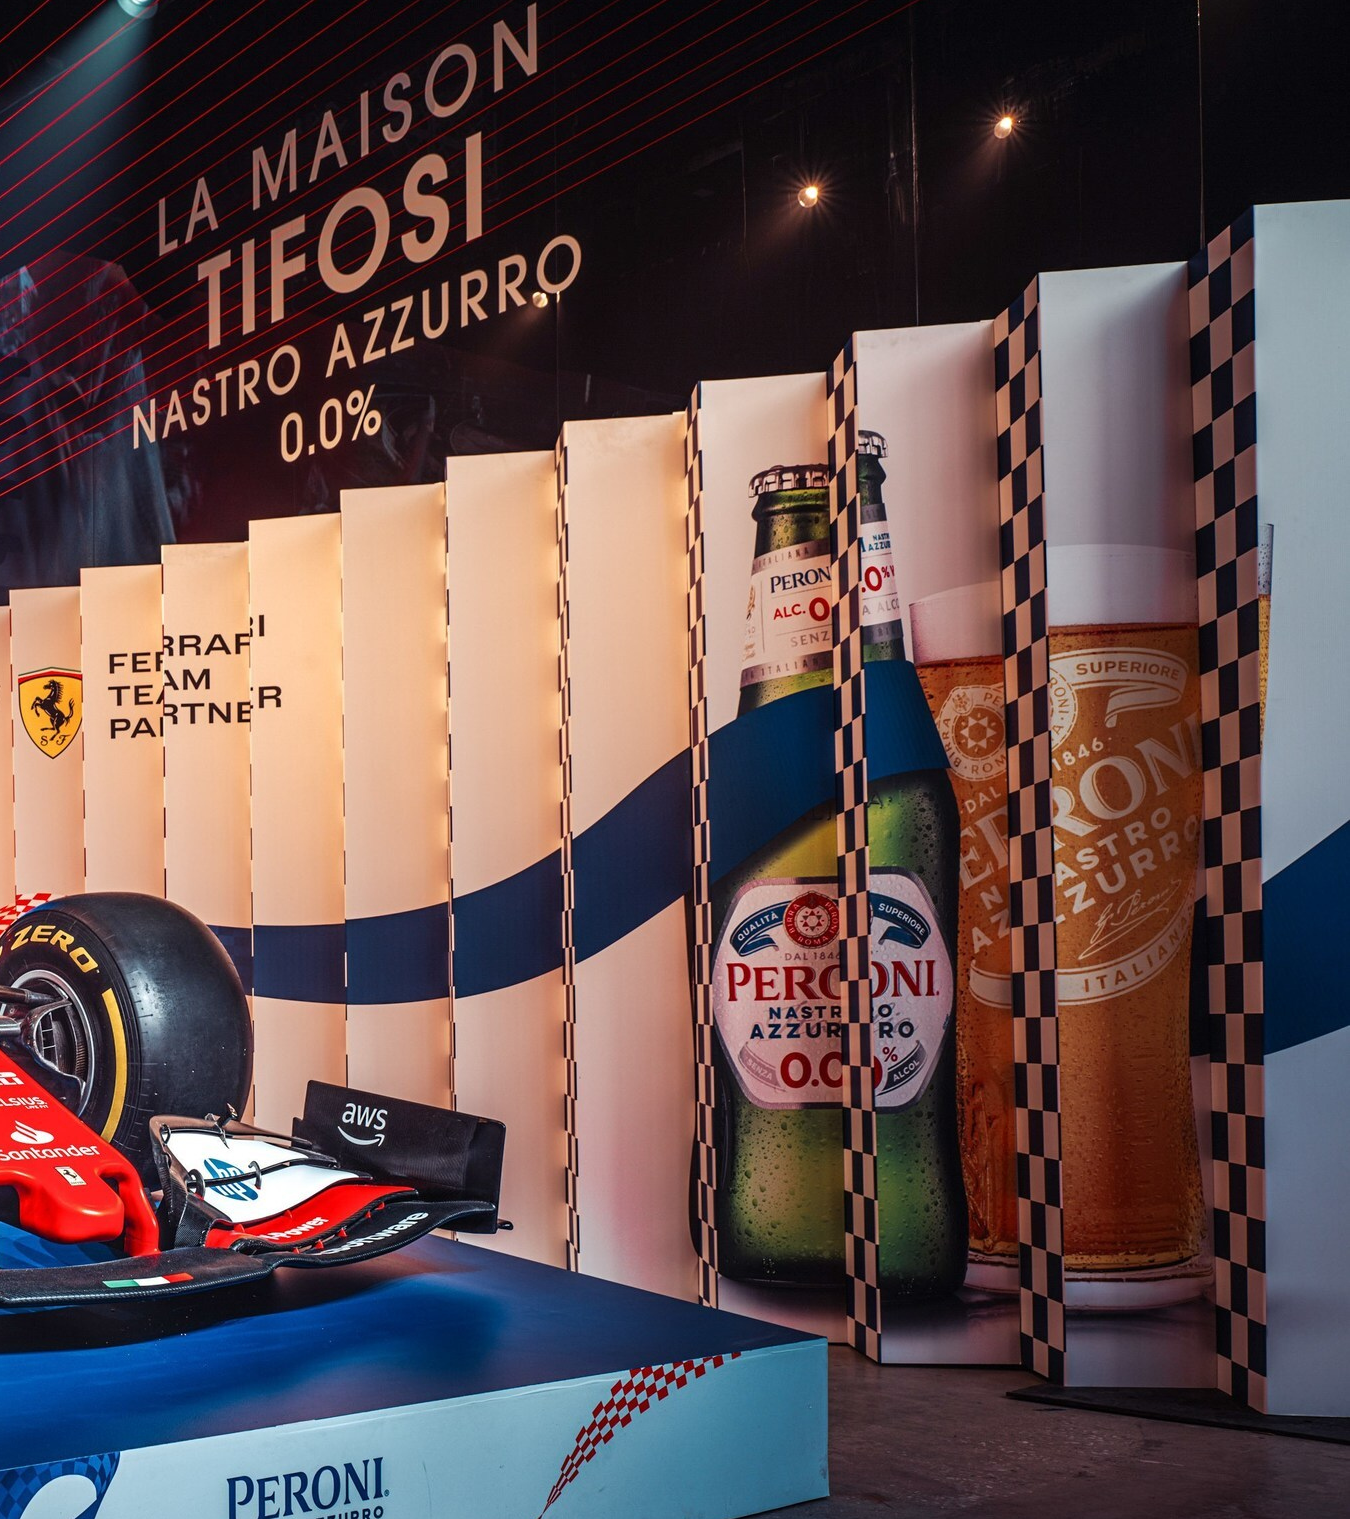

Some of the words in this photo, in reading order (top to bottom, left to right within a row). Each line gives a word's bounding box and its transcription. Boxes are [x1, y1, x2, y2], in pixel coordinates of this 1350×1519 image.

[158, 177, 219, 257] LA
[252, 2, 538, 211] MAISON
[197, 132, 483, 350] TIFOSI
[133, 344, 302, 450] NASTRO
[325, 234, 582, 379] AZZURRO
[280, 384, 382, 463] 0.0%
[773, 603, 806, 620] ALC.
[108, 669, 210, 706] TEAM
[1076, 660, 1180, 681] SUPERIORE
[110, 686, 282, 739] PARTNER
[964, 786, 1001, 814] DAL
[1052, 736, 1104, 772] 1846
[737, 911, 779, 942] QUALITÀ
[789, 903, 800, 934] BIRRA
[824, 901, 840, 934] PERONI
[878, 902, 926, 937] SUPERIORE
[10, 925, 100, 974] ZERO
[784, 953, 808, 961] DAL
[797, 935, 829, 945] ROMA
[892, 1058, 920, 1083] ALCOL
[341, 1103, 388, 1130] aws
